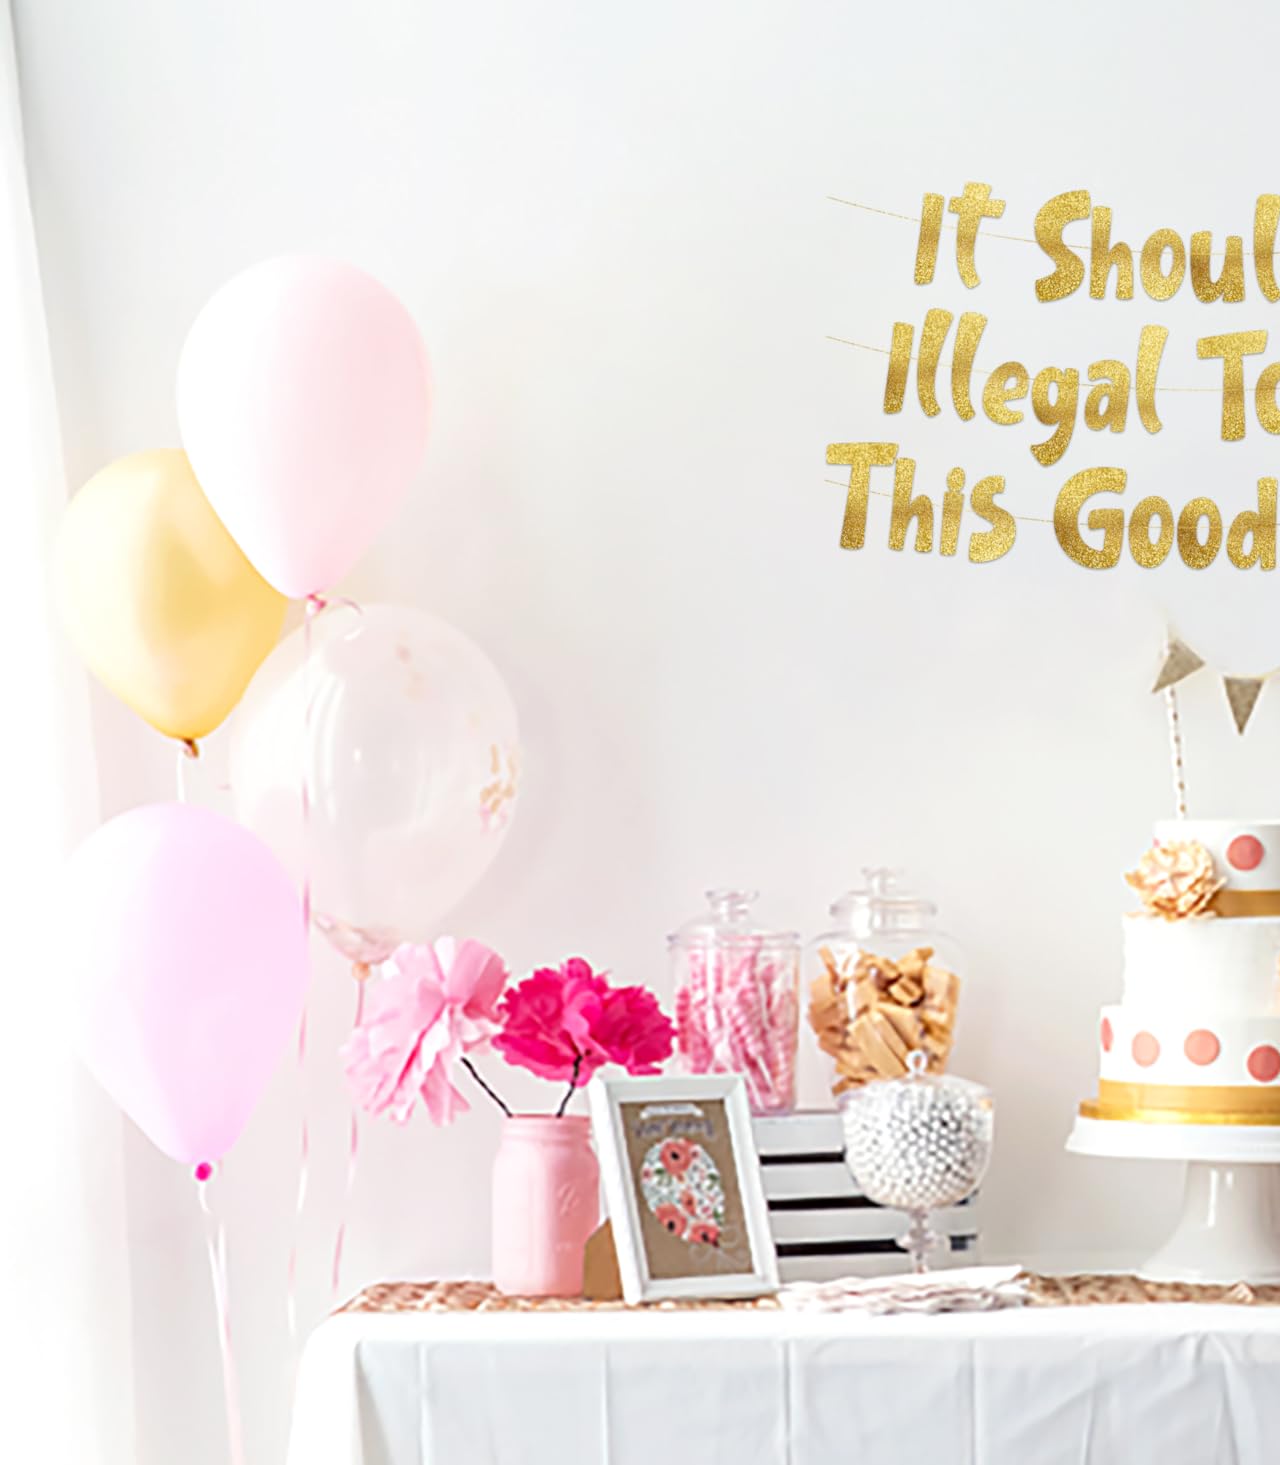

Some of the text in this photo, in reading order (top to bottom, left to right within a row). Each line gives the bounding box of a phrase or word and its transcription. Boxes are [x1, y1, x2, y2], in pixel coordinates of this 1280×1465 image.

[913, 181, 1006, 289] It
[882, 308, 1169, 466] Illegal
[825, 442, 1017, 563] This
[1053, 466, 1279, 572] Good
